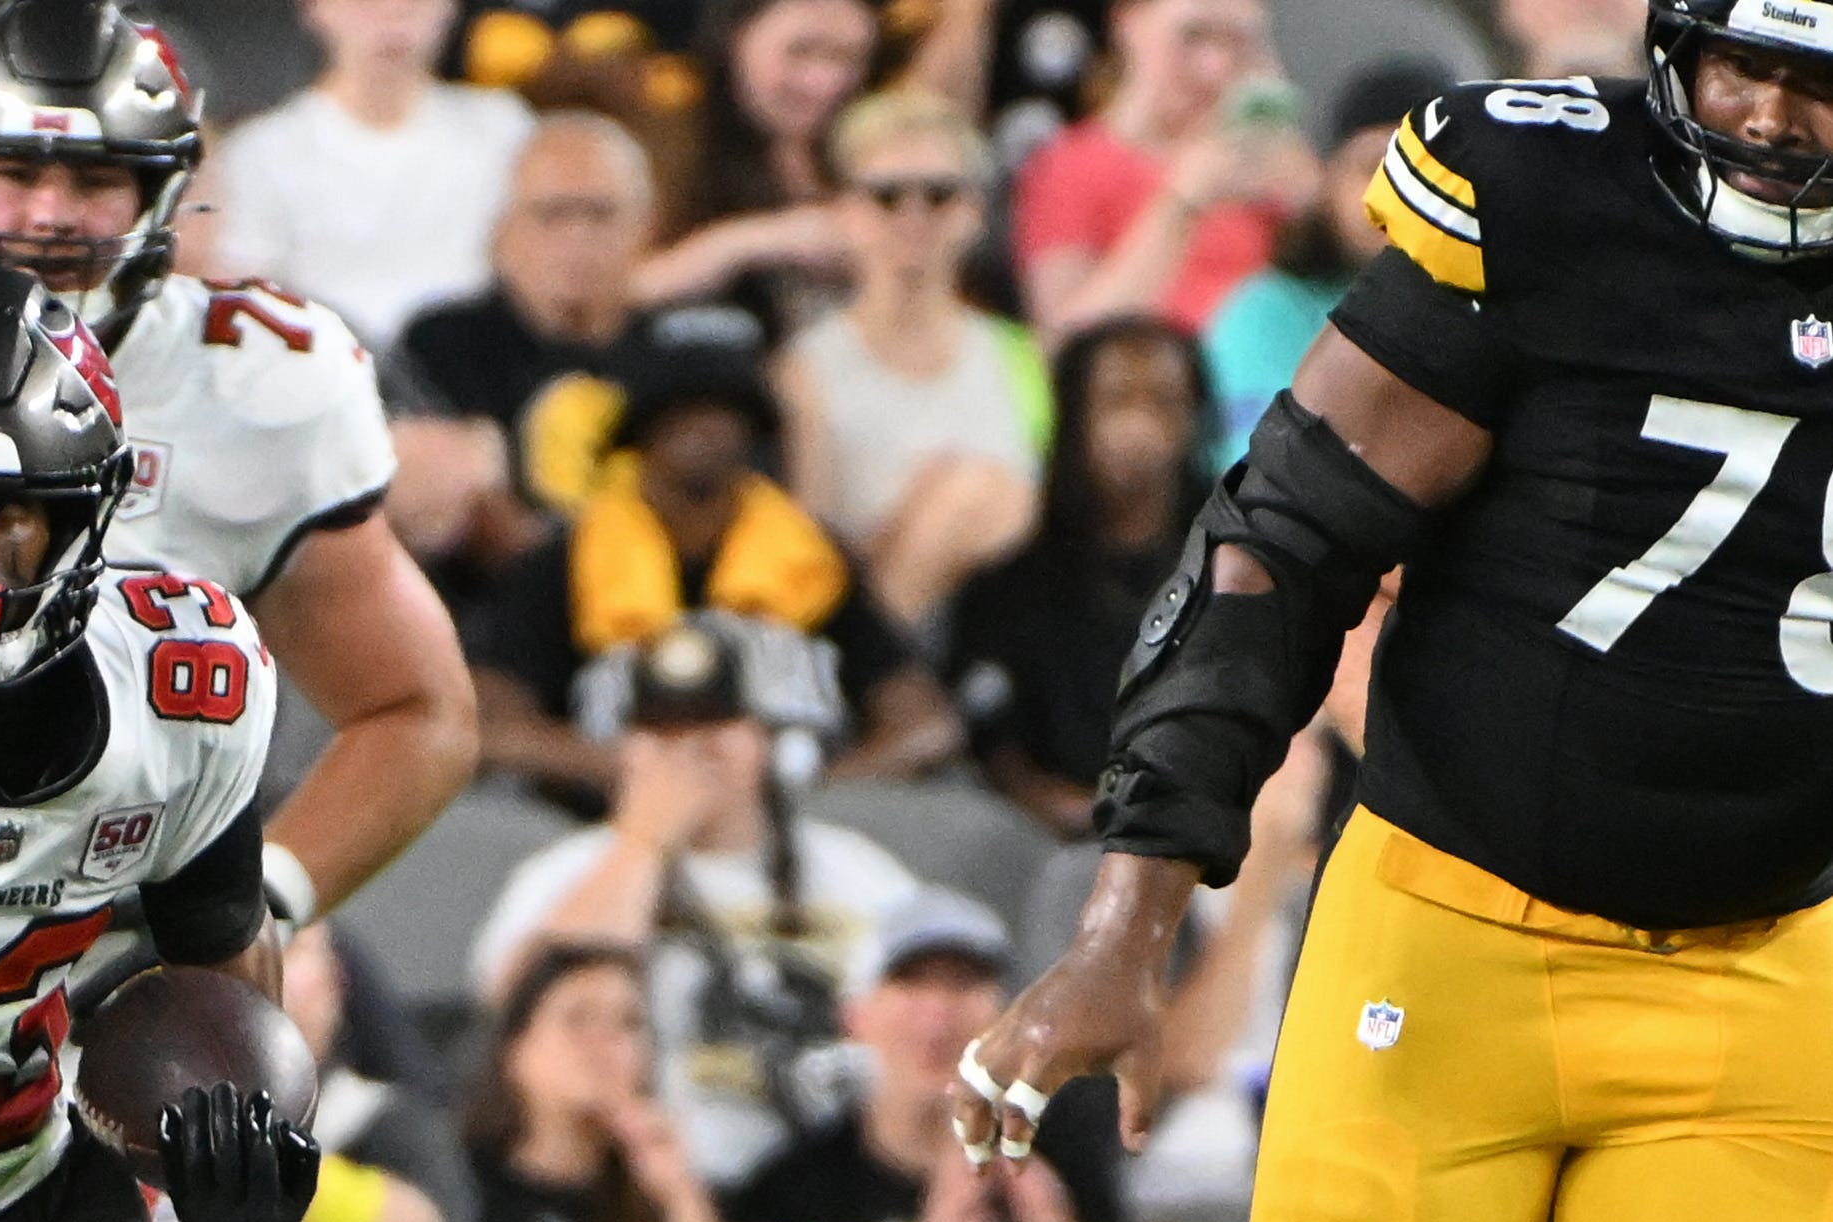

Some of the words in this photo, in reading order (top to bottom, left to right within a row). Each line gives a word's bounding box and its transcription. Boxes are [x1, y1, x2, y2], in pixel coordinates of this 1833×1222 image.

[1761, 1, 1818, 28] Steelers
[123, 572, 250, 726] 83
[93, 811, 154, 853] 50
